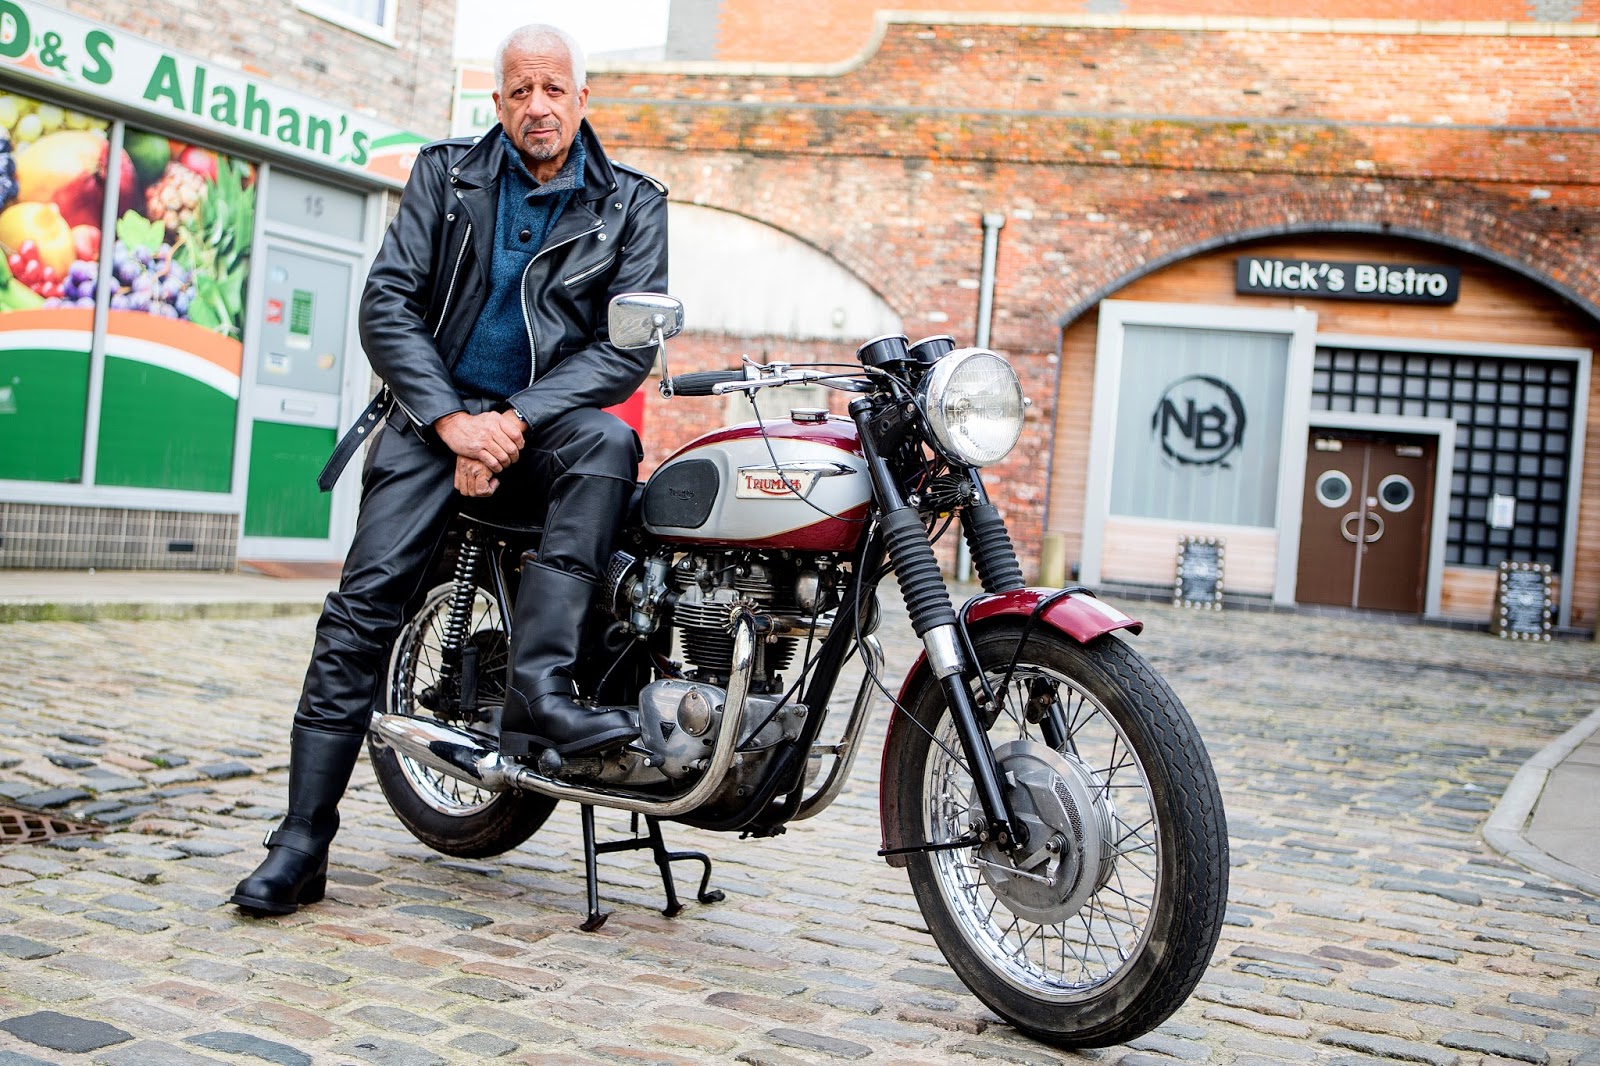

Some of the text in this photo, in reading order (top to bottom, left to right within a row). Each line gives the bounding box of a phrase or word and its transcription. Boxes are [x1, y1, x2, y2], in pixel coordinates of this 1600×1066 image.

[143, 55, 368, 165] Alahan's
[304, 194, 325, 218] 15
[1249, 259, 1448, 296] Nick's Bistro
[1161, 398, 1229, 450] NB
